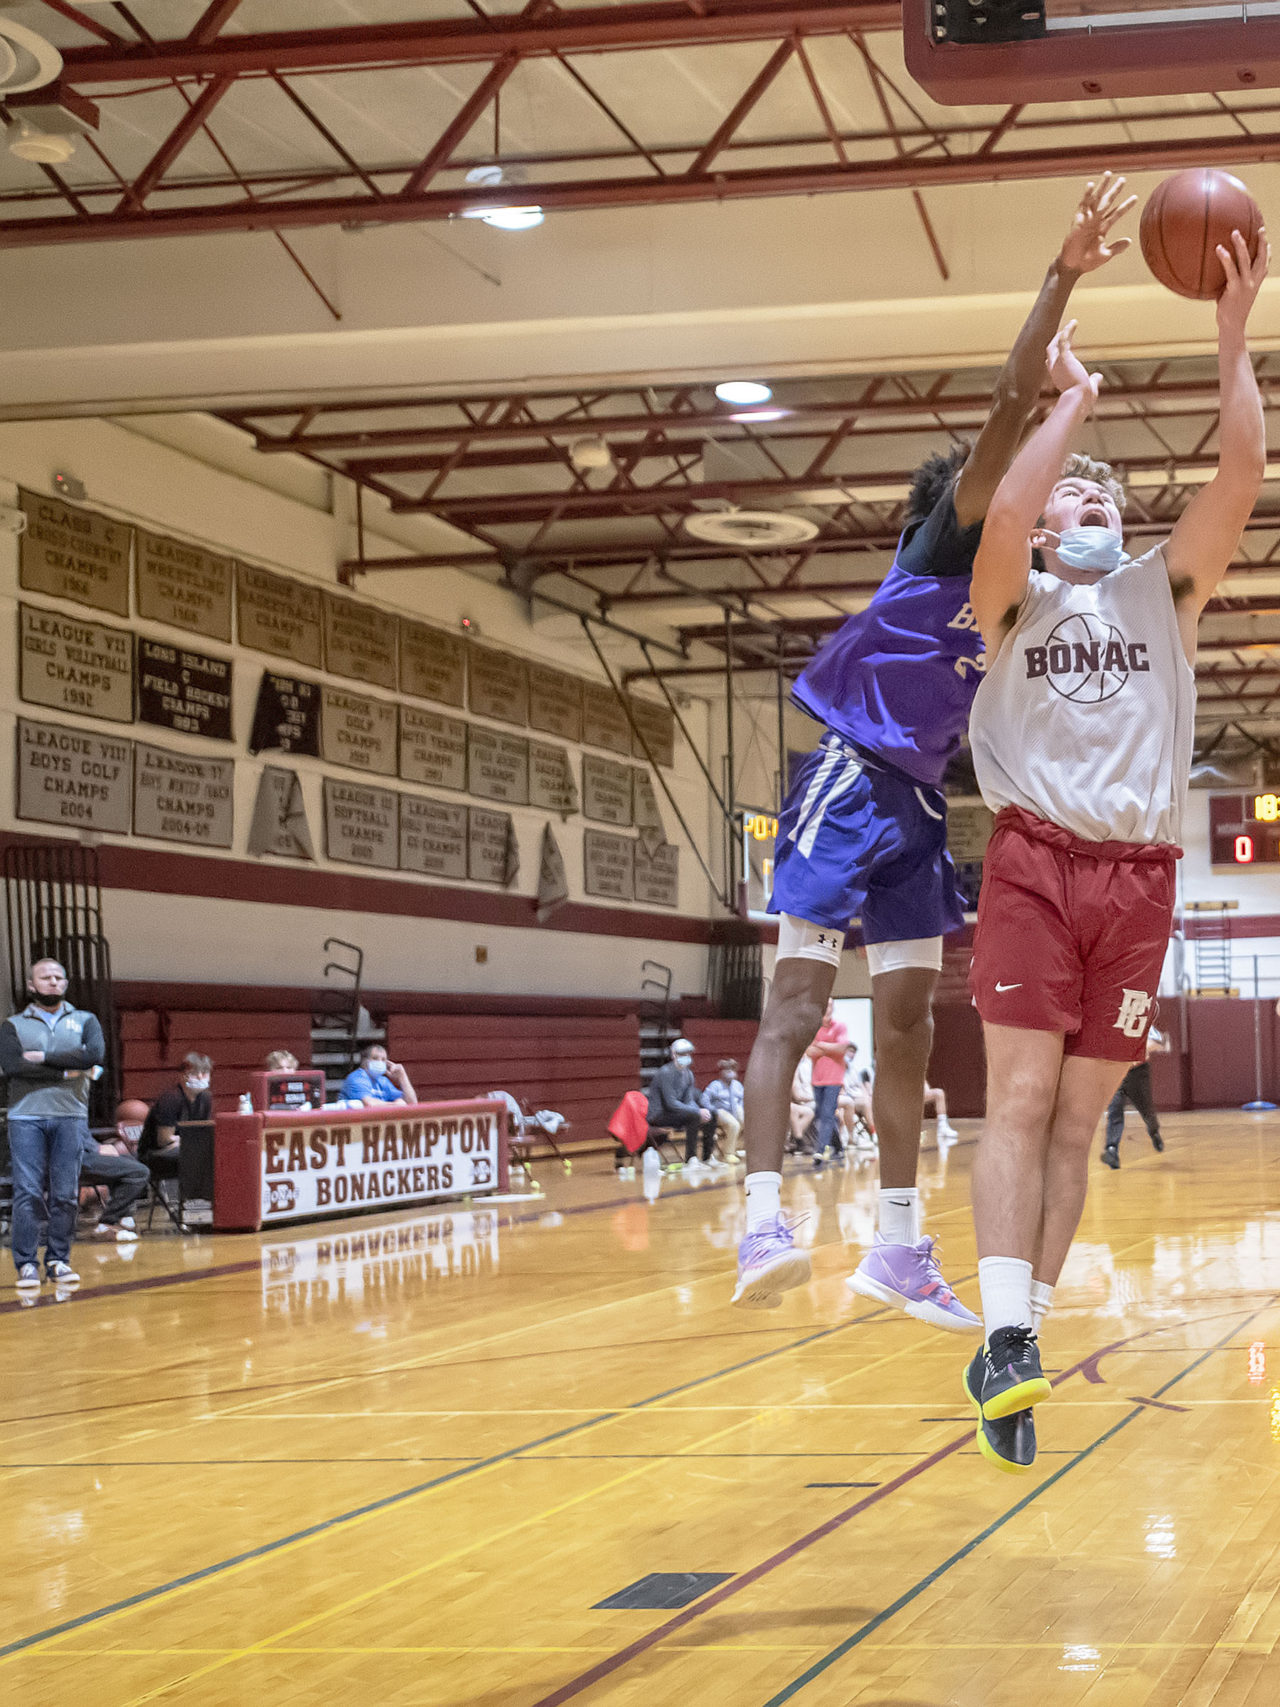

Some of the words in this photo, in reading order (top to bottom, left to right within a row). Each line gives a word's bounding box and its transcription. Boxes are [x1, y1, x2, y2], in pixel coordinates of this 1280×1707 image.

[28, 613, 94, 646] LEAGUE
[145, 643, 177, 663] LONG
[182, 654, 226, 677] ISLAND
[1024, 640, 1150, 679] BONAC
[45, 661, 111, 692] CHAMPS
[143, 674, 180, 696] FIELD
[163, 695, 210, 719] CHAMPS
[24, 726, 92, 756] LEAGUE
[30, 750, 72, 774] BOYS
[81, 760, 121, 782] GOLF
[145, 752, 205, 779] LEAGUE
[43, 776, 110, 803] CHAMPS
[332, 786, 376, 807] LEAGUE
[157, 796, 215, 819] CHAMPS
[341, 823, 384, 843] CHAMPS
[1235, 835, 1253, 863] 0
[264, 1127, 352, 1175] EAST
[361, 1115, 491, 1165] HAMPTON
[316, 1162, 453, 1206] BONACKERS
